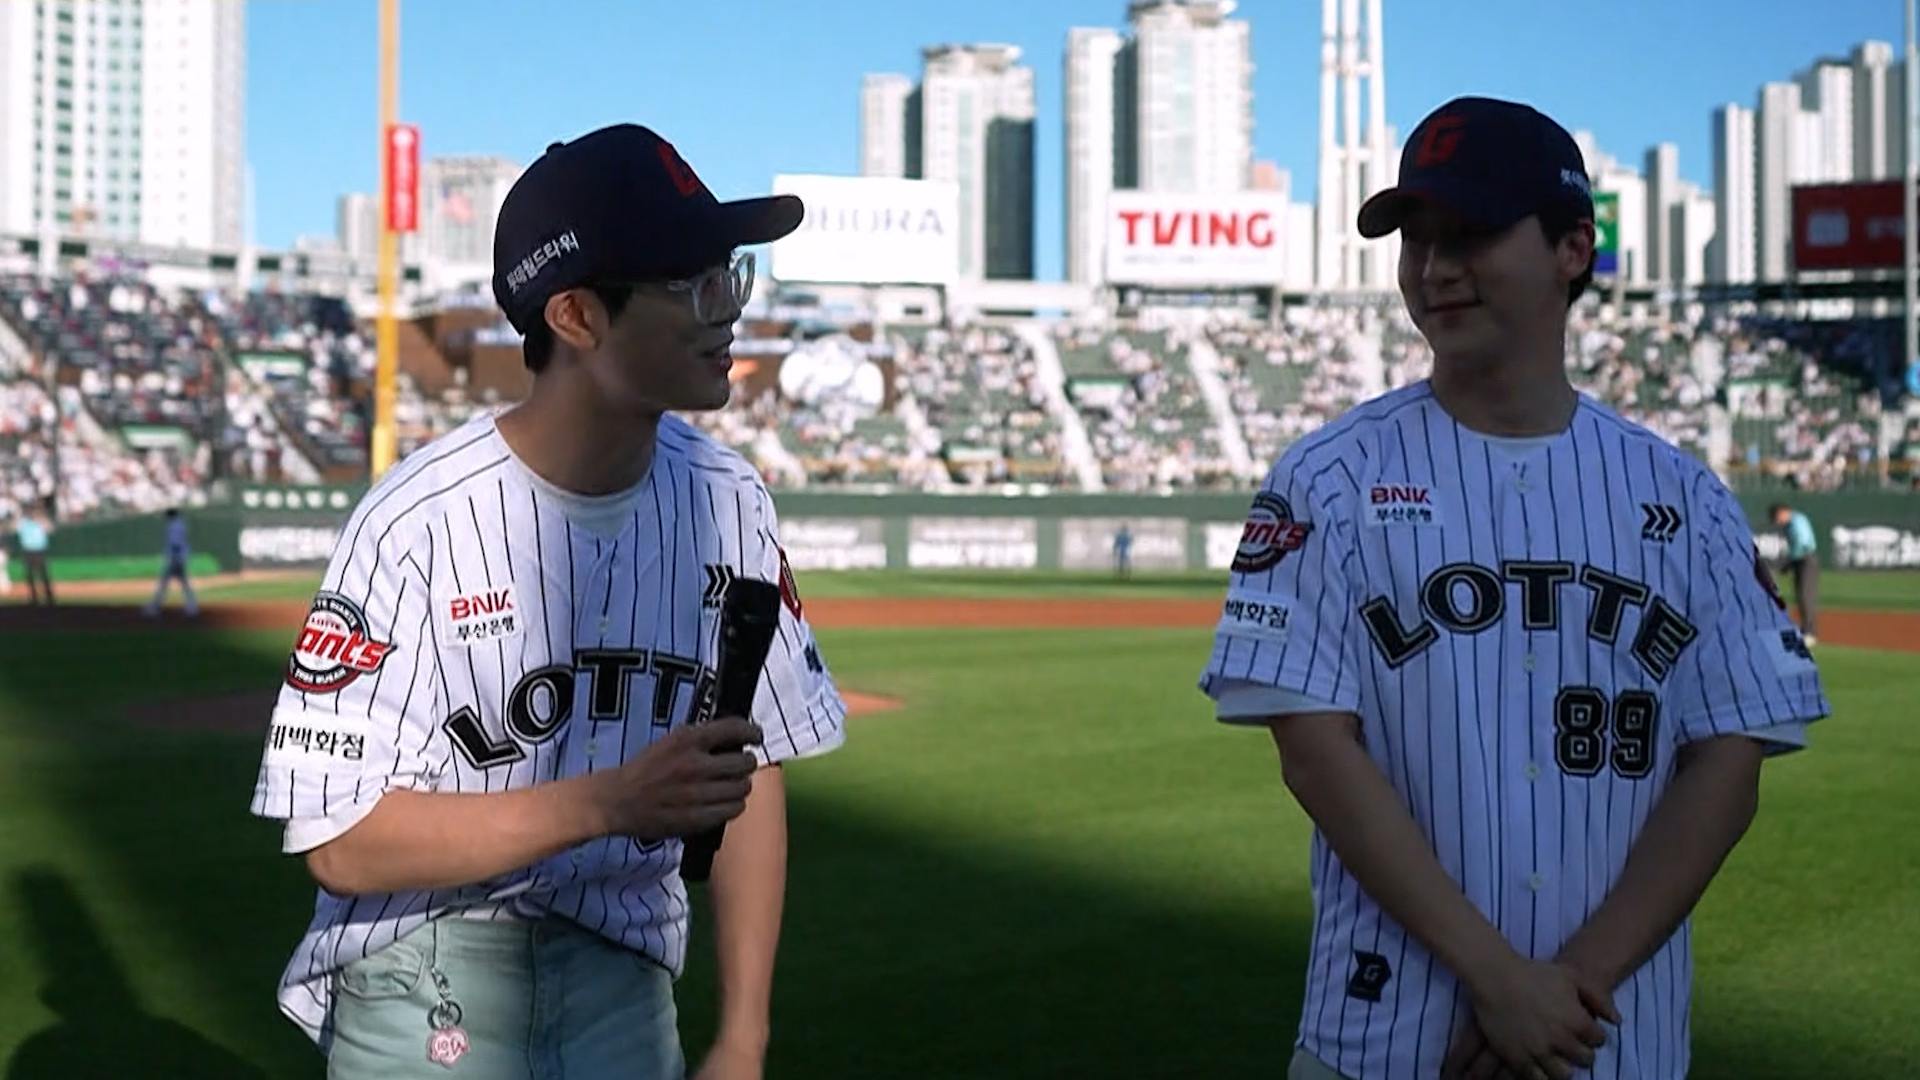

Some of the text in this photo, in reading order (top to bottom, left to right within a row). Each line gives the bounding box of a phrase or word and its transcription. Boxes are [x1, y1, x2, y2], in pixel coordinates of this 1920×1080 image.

[1415, 115, 1469, 168] G
[1118, 211, 1274, 248] TVING
[506, 230, 580, 294] 롯데월드타워
[1370, 486, 1431, 505] BNK
[1375, 507, 1432, 523] 부산은행
[450, 588, 514, 621] BNK
[1358, 560, 1698, 683] LOTTE
[456, 614, 515, 641] 부산은행
[1554, 687, 1660, 778] 89
